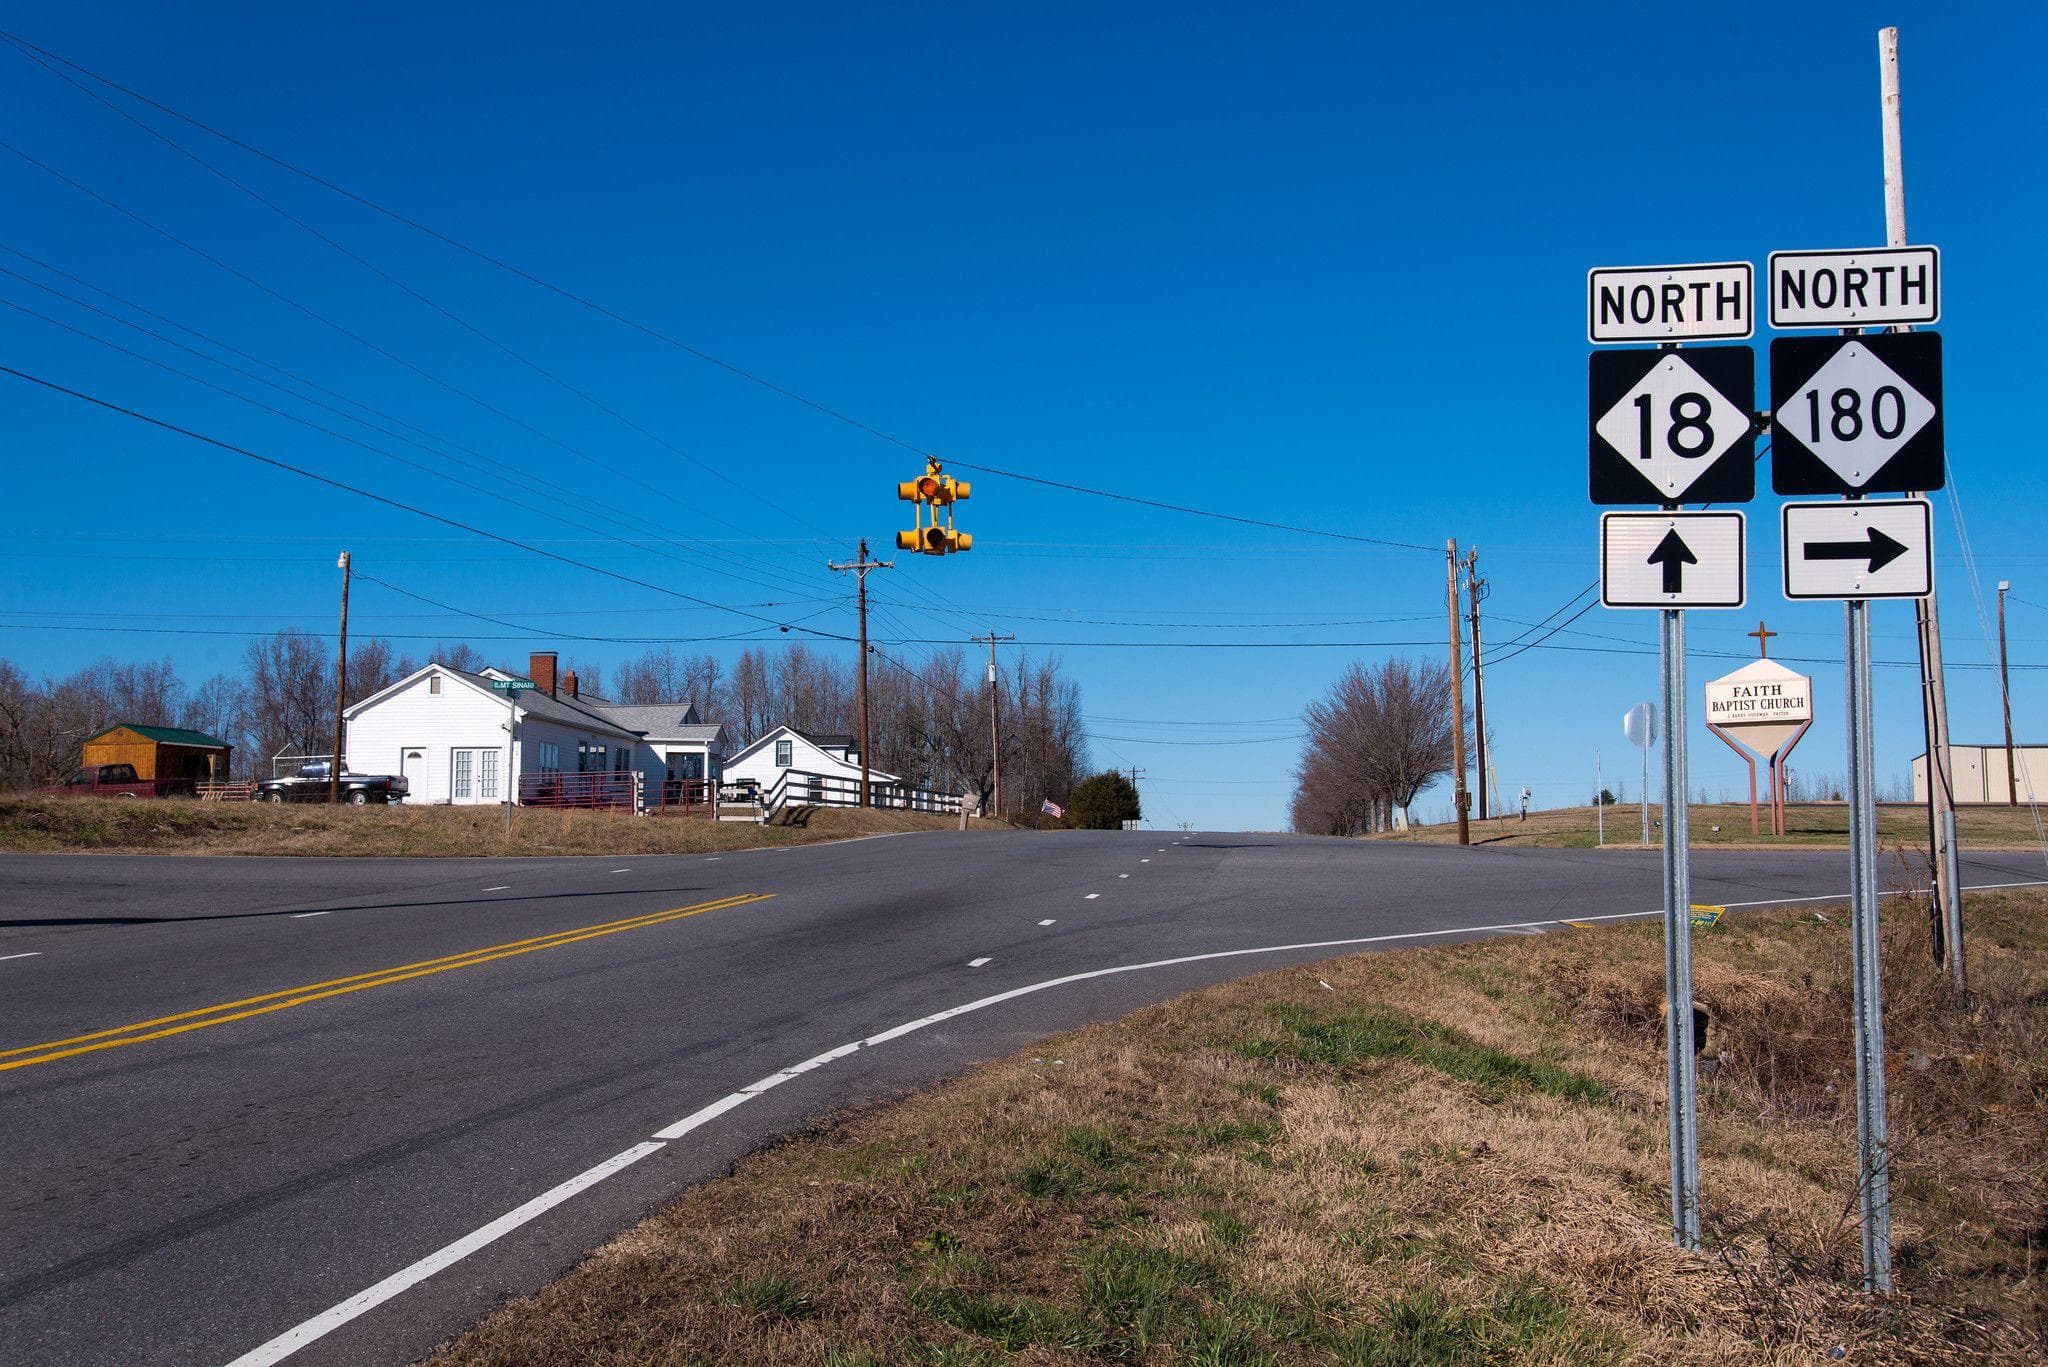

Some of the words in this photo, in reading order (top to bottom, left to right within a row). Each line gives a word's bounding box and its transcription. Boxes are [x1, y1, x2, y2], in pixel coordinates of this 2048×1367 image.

[1601, 281, 1741, 325] NORTH
[1780, 265, 1927, 309] NORTH
[1634, 392, 1715, 459] 18
[1806, 385, 1907, 443] 180
[1712, 700, 1756, 712] BAPTIST
[1760, 697, 1804, 709] CHURCH
[1733, 685, 1782, 697] FAITH
